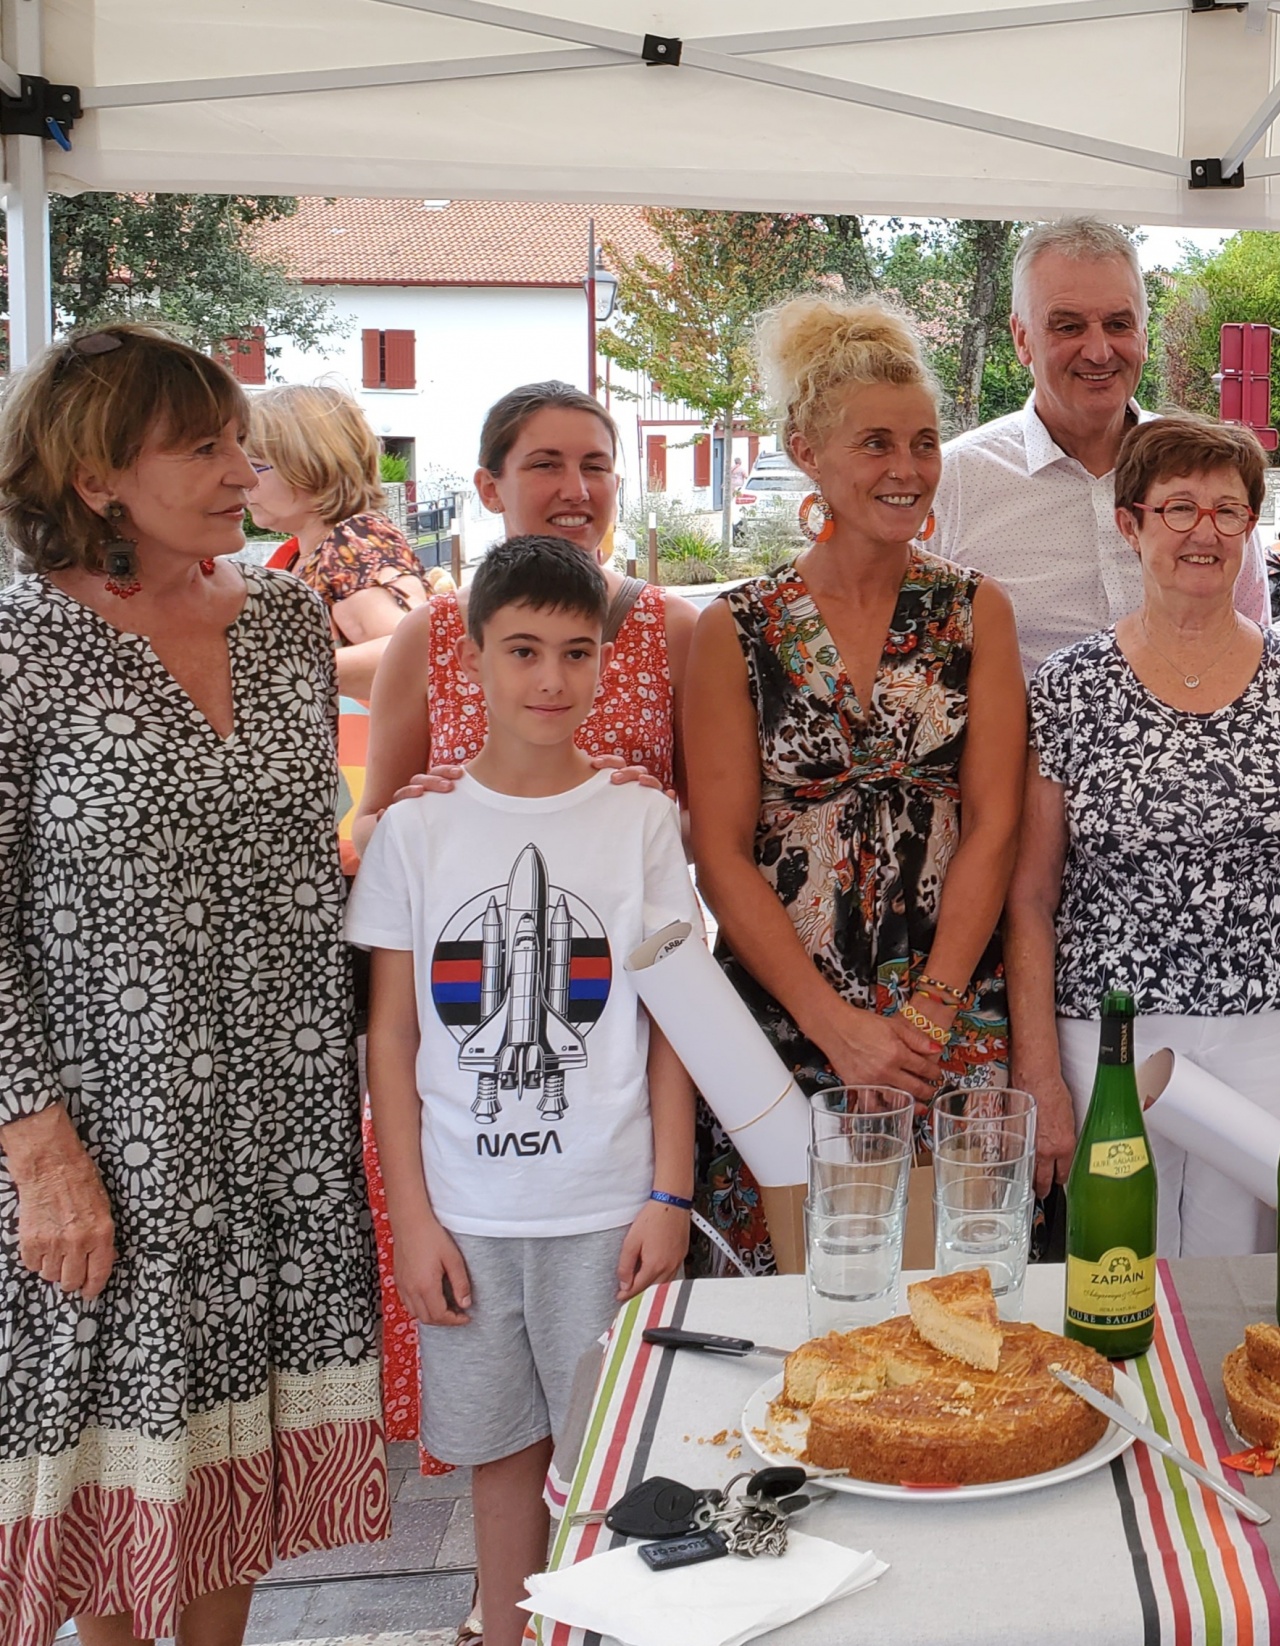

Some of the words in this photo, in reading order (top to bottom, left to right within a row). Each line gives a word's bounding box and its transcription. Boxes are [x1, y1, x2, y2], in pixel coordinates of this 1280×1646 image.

[476, 1129, 563, 1158] NASA
[1090, 1269, 1145, 1286] ZAPIAIN
[1070, 1309, 1097, 1324] GURE
